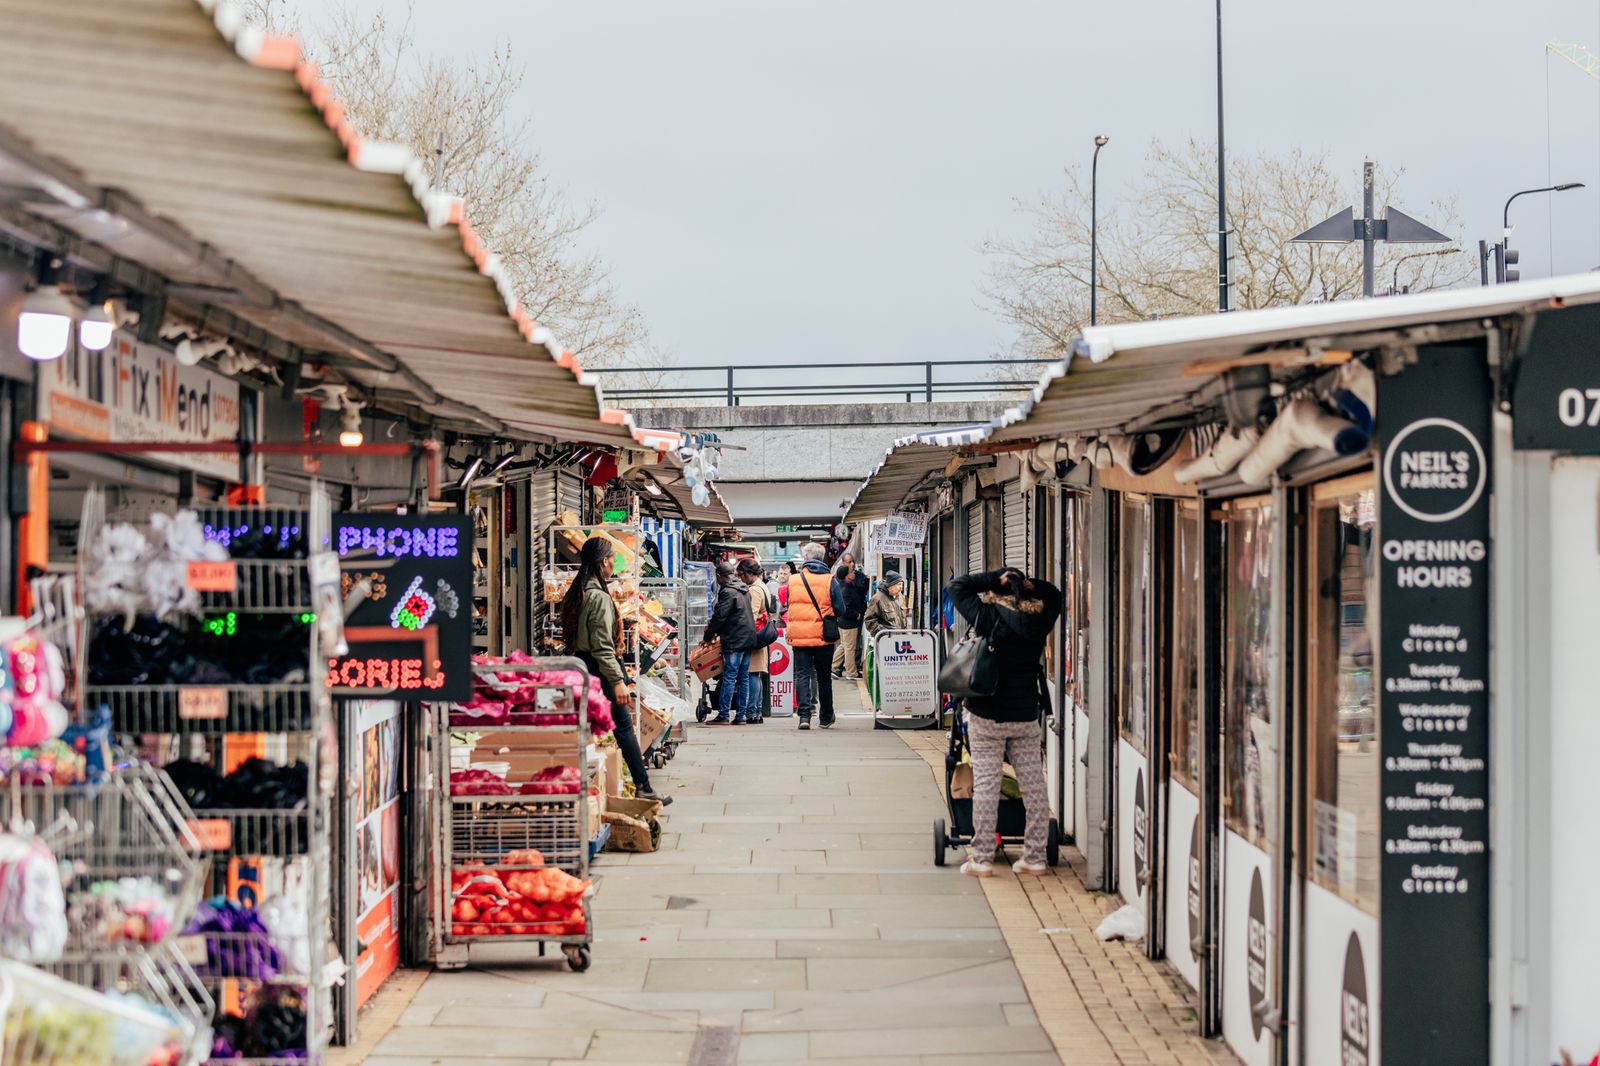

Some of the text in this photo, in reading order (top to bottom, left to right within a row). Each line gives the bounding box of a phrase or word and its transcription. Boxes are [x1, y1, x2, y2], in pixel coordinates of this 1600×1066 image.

[1558, 387, 1600, 427] 07
[1400, 450, 1470, 473] NEIL'S
[1401, 471, 1468, 489] FABRICS
[339, 527, 458, 556] PHONE
[897, 530, 922, 540] PHONES
[1382, 539, 1486, 562] OPENING
[1397, 566, 1472, 588] HOURS
[1408, 623, 1460, 640] Monday
[884, 654, 928, 662] UNITYLINK
[1409, 663, 1460, 678] Tuesday
[777, 681, 792, 693] CUT
[1399, 703, 1471, 719] Wednesday
[1407, 742, 1463, 757] Thursday
[1415, 781, 1454, 796] Friday
[1407, 824, 1463, 840] Saturday
[1411, 863, 1458, 879] Sunday
